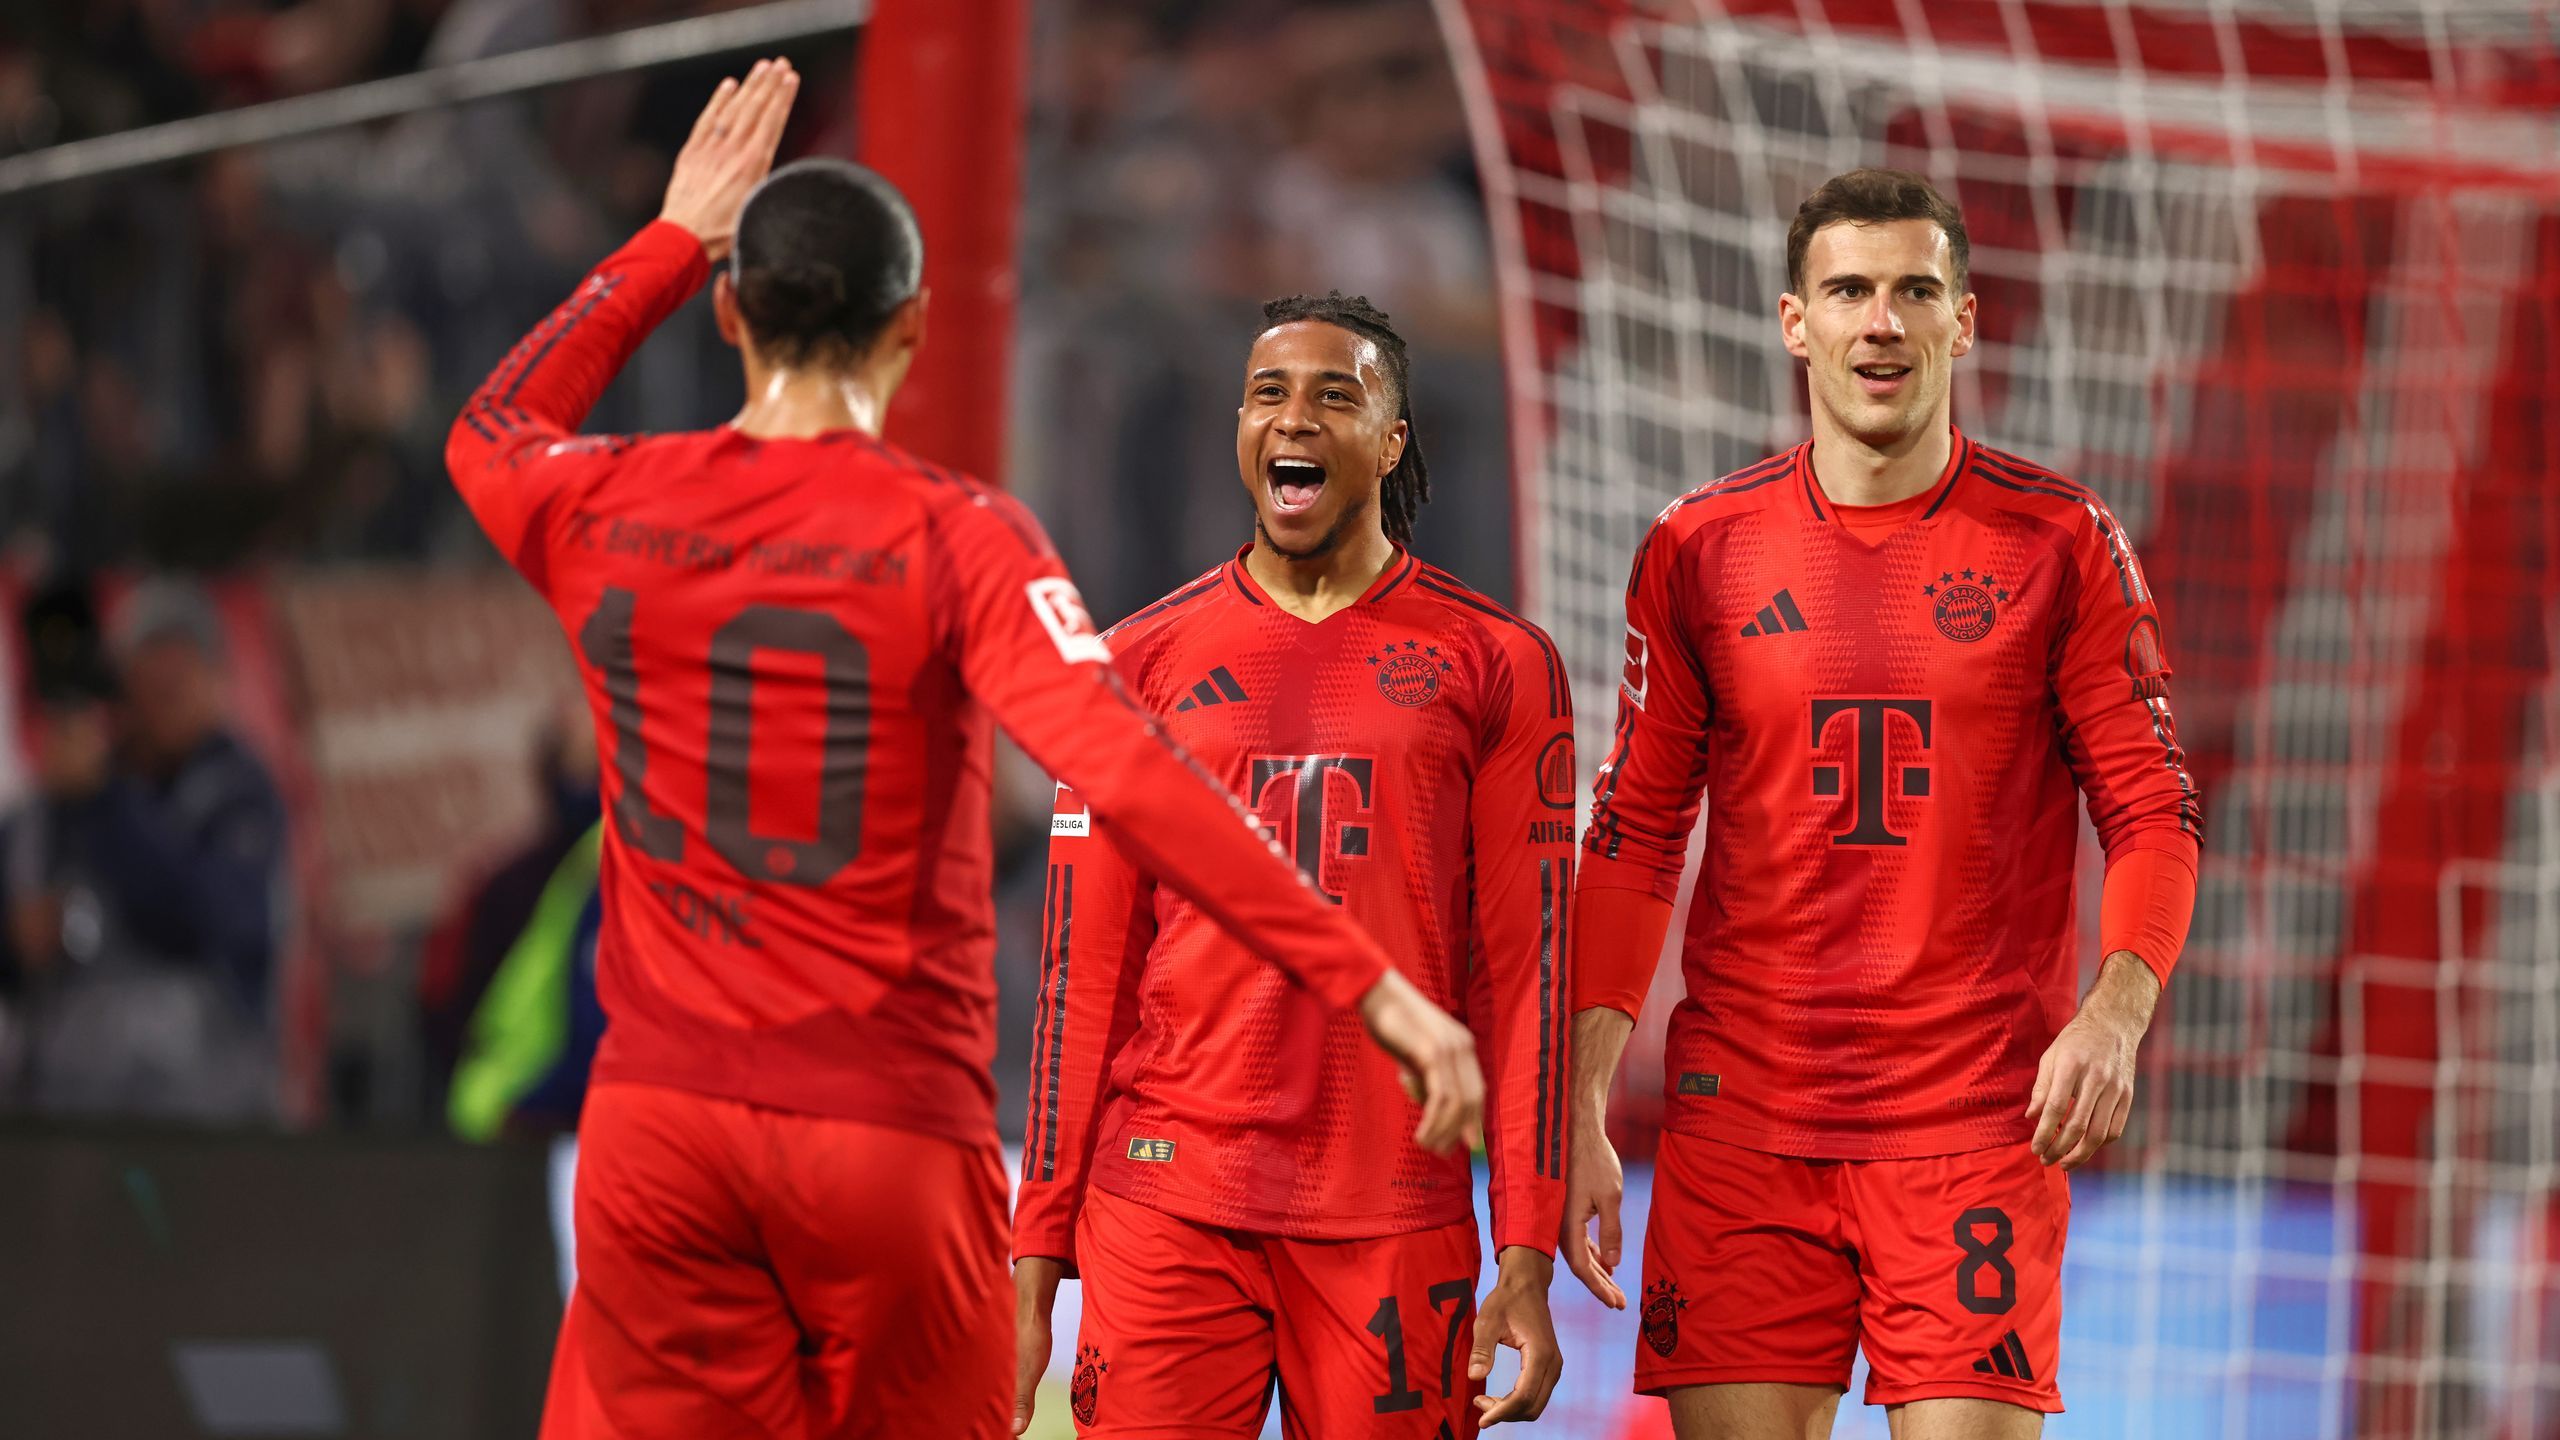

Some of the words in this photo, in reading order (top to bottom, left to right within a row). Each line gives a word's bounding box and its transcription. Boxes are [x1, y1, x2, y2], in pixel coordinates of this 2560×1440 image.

[1397, 658, 1434, 679] BAYERN
[1953, 588, 1990, 612] BAYERN
[580, 585, 870, 888] 10
[1812, 700, 1931, 845] T
[1250, 759, 1372, 905] T
[1953, 1207, 2016, 1315] 8
[1366, 1277, 1472, 1414] 17
